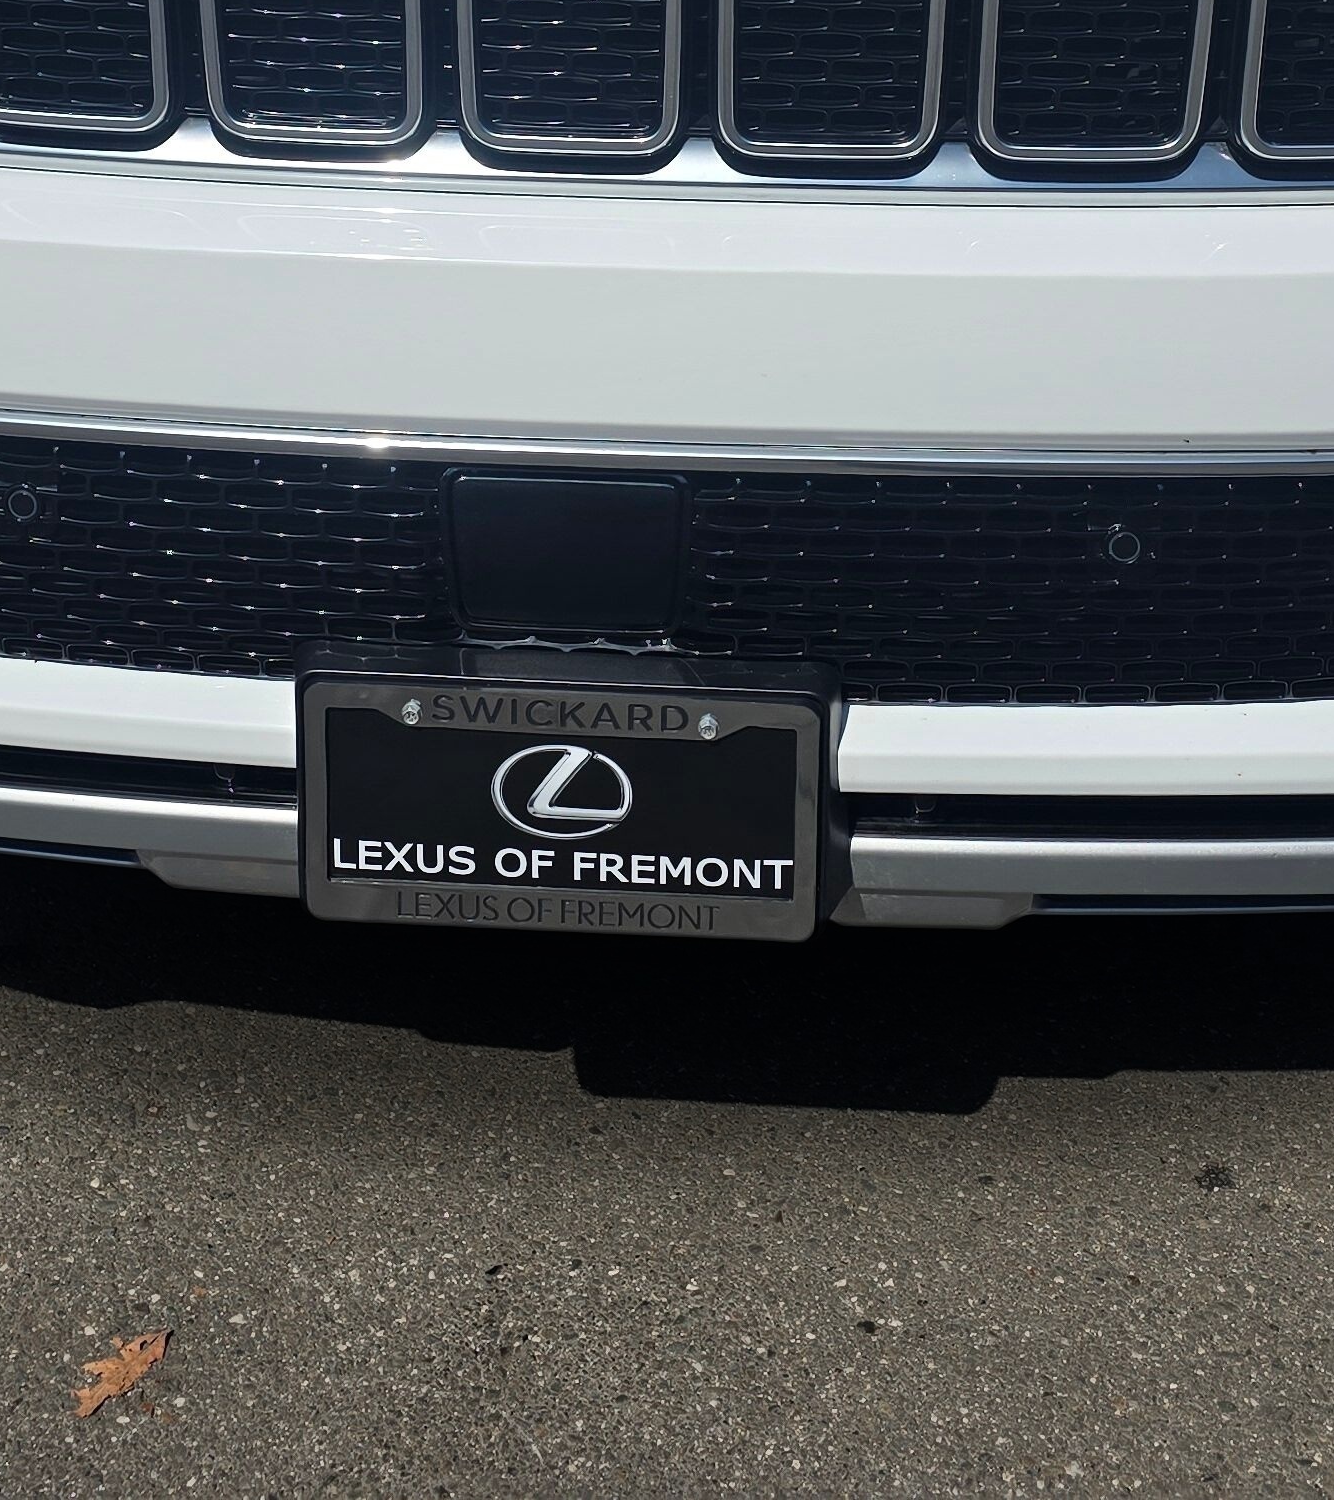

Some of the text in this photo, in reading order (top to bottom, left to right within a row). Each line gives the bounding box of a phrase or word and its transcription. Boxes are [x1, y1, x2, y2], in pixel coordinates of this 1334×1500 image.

[431, 694, 689, 732] SWICKARD
[333, 838, 794, 890] LEXUS OF FREMONT
[396, 891, 721, 930] LEXUS OF FREMONT
